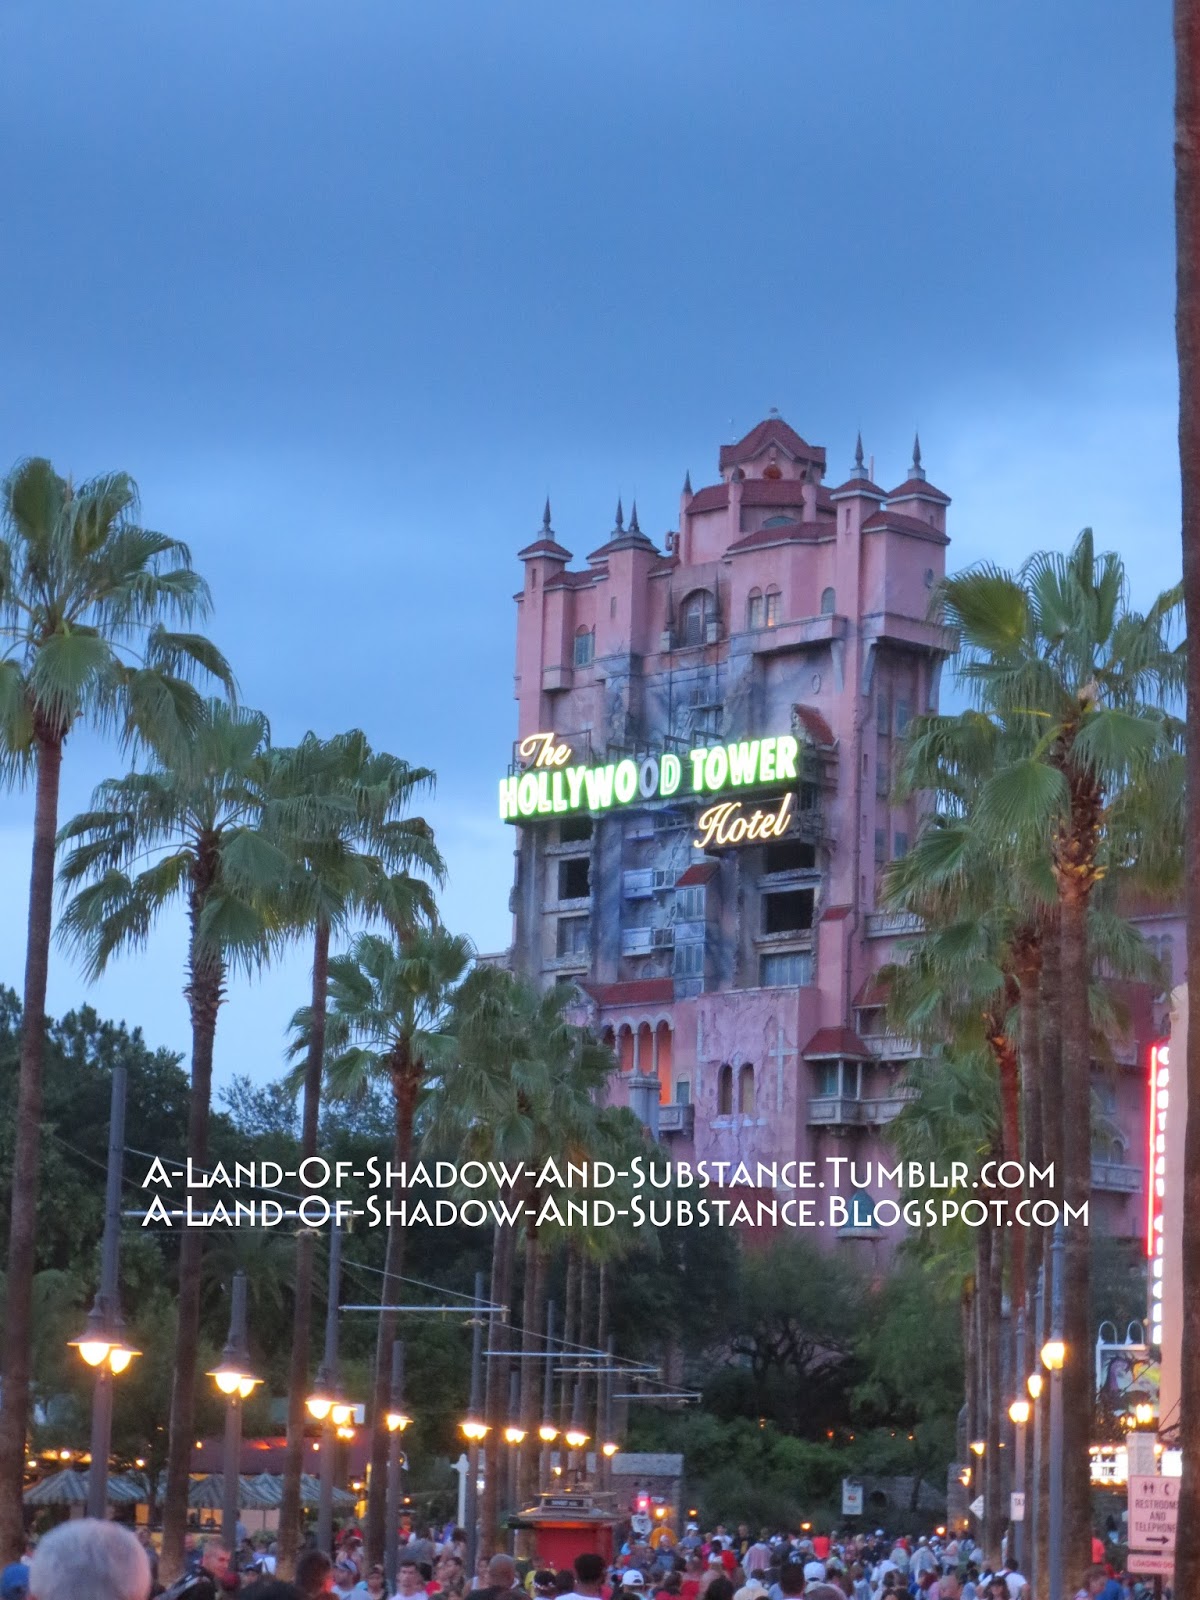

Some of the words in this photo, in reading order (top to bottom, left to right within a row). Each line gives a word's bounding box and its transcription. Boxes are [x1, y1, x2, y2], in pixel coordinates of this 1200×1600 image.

[519, 732, 572, 769] The
[499, 754, 682, 819] HOLLYWOOD
[690, 735, 799, 791] TOWER
[693, 792, 793, 848] Hotel
[1149, 1511, 1166, 1521] AND
